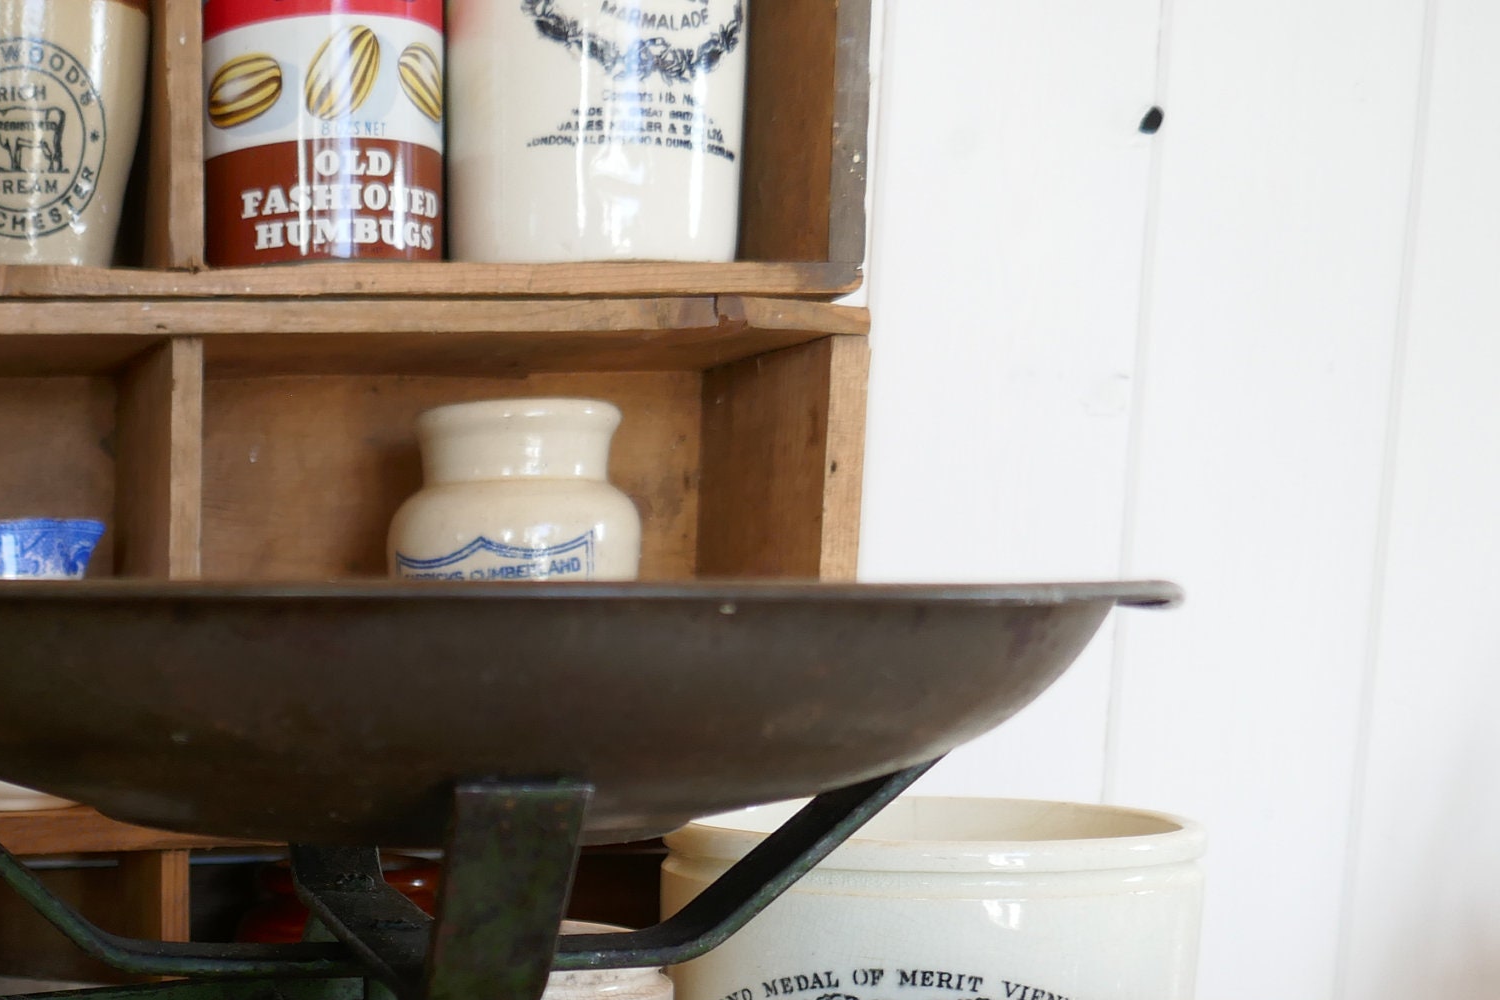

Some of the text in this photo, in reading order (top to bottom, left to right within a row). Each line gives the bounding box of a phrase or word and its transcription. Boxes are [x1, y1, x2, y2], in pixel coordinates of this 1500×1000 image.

[321, 121, 330, 135] 8
[364, 122, 386, 135] NET
[314, 149, 393, 177] OLD
[240, 182, 439, 220] FASHIONED
[254, 217, 435, 251] HUMBUGS
[762, 970, 839, 998] MEDAL
[852, 968, 884, 986] OF
[897, 968, 983, 992] MERIT
